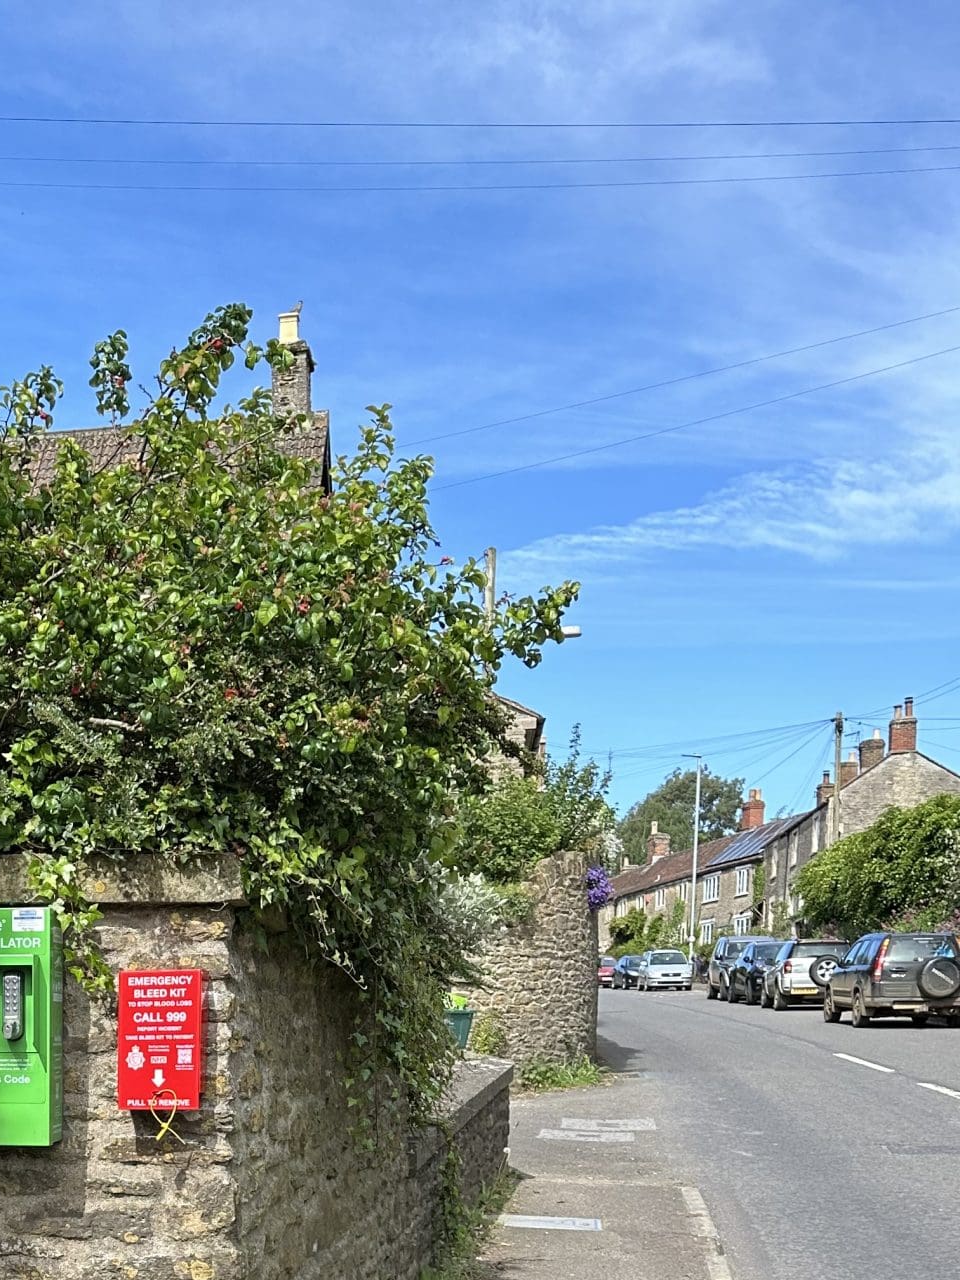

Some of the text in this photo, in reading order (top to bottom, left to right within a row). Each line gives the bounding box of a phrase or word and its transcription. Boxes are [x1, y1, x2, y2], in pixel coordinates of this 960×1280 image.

[128, 975, 193, 986] EMERGENCY
[133, 988, 187, 998] BLEED KIT
[133, 1011, 187, 1023] CALL 999
[4, 1074, 30, 1083] Code
